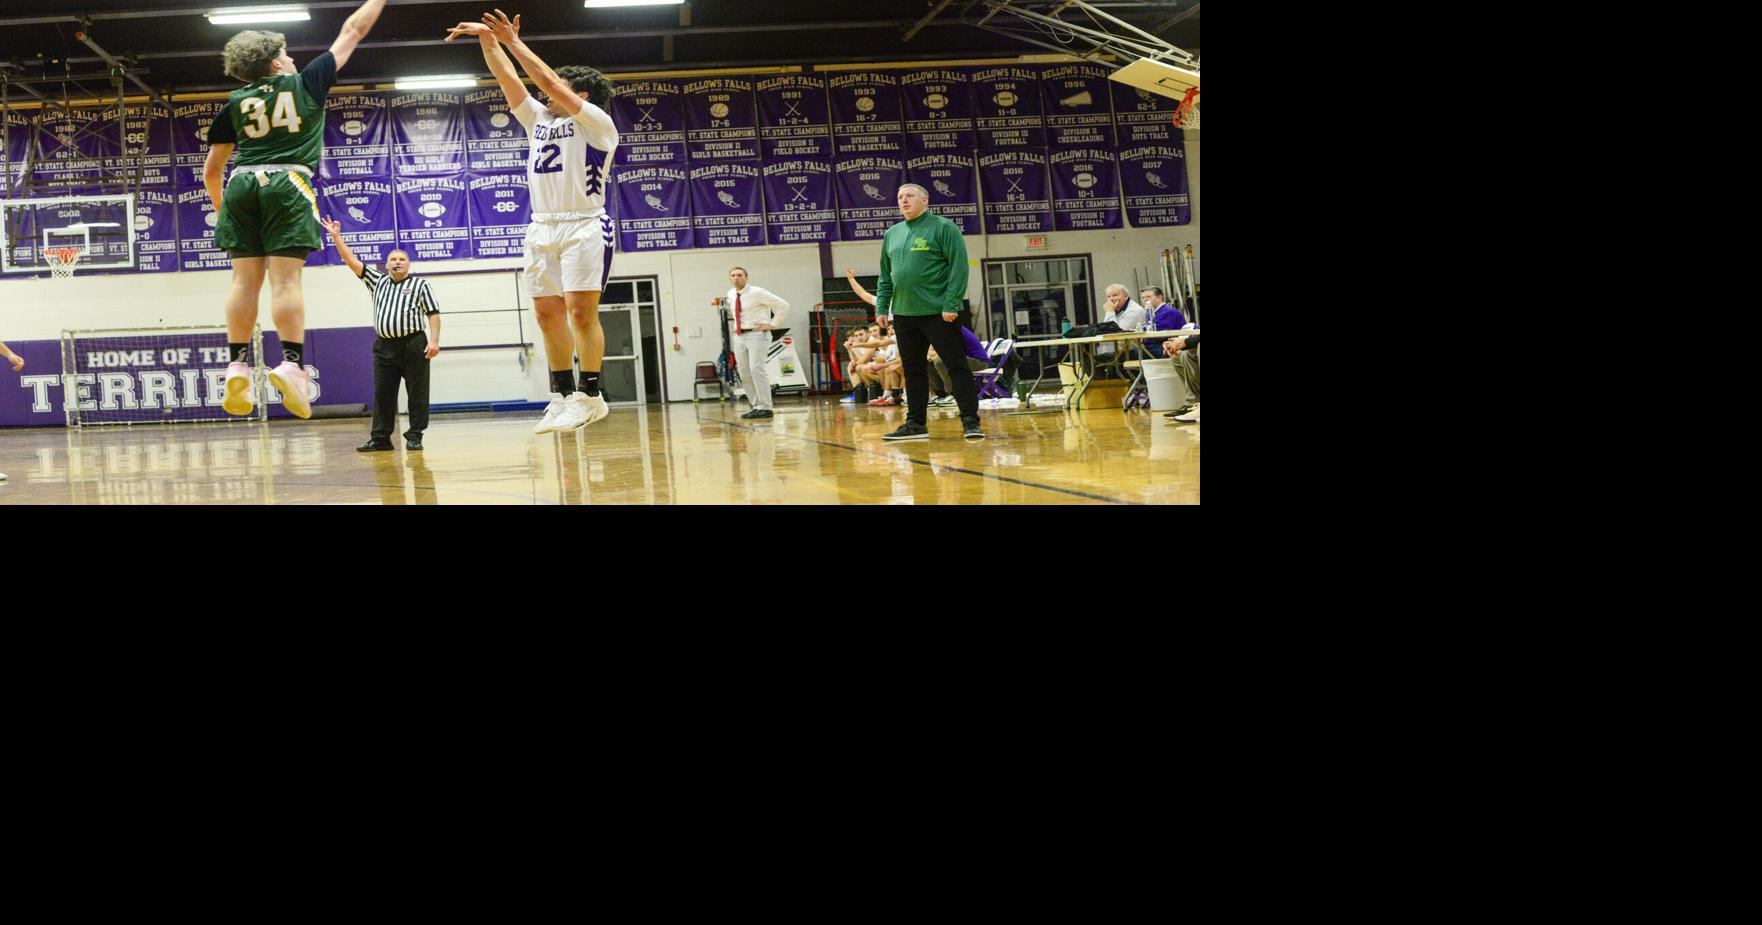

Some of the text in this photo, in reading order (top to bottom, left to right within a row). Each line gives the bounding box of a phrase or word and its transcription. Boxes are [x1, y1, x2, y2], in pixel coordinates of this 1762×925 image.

[830, 74, 868, 87] BELLOWS
[871, 74, 896, 84] FALLS
[901, 71, 939, 85] BELLOWS
[942, 71, 966, 82] FALLS
[972, 68, 1008, 82] BELLOWS
[1012, 69, 1036, 79] FALLS
[612, 82, 678, 96] BELLOWS FALLS
[684, 80, 722, 94] BELLOWS
[725, 80, 751, 90] FALLS
[757, 77, 795, 91] BELLOWS
[798, 76, 823, 88] FALLS
[360, 96, 386, 107] FALLS
[392, 93, 430, 107] BELLOWS
[433, 93, 459, 104] FALLS
[174, 104, 212, 118] BELLOWS
[240, 92, 301, 138] 34
[634, 123, 662, 131] 10-3-3
[980, 153, 1017, 166] BELLOWS
[1020, 152, 1044, 164] FALLS
[1051, 150, 1087, 164] BELLOWS
[1090, 150, 1114, 160] FALLS
[1120, 147, 1156, 160] BELLOWS
[1159, 147, 1183, 157] FALLS
[763, 162, 802, 176] BELLOWS
[805, 161, 831, 172] FALLS
[836, 158, 874, 172] BELLOWS
[877, 158, 902, 169] FALLS
[908, 155, 945, 169] BELLOWS
[948, 155, 973, 166] FALLS
[618, 168, 656, 182] BELLOWS
[659, 168, 686, 179] FALLS
[690, 165, 729, 179] BELLOWS
[732, 165, 758, 176] FALLS
[323, 183, 362, 196] BELLOWS
[365, 182, 391, 193] FALLS
[396, 179, 435, 193] BELLOWS
[439, 178, 464, 190] FALLS
[470, 176, 509, 190] BELLOWS
[148, 192, 172, 203] FALLS
[654, 219, 690, 227] CHAMPIONS
[726, 216, 762, 224] CHAMPIONS
[433, 229, 468, 238] CHAMPIONS
[87, 346, 230, 368] HOME OF TH
